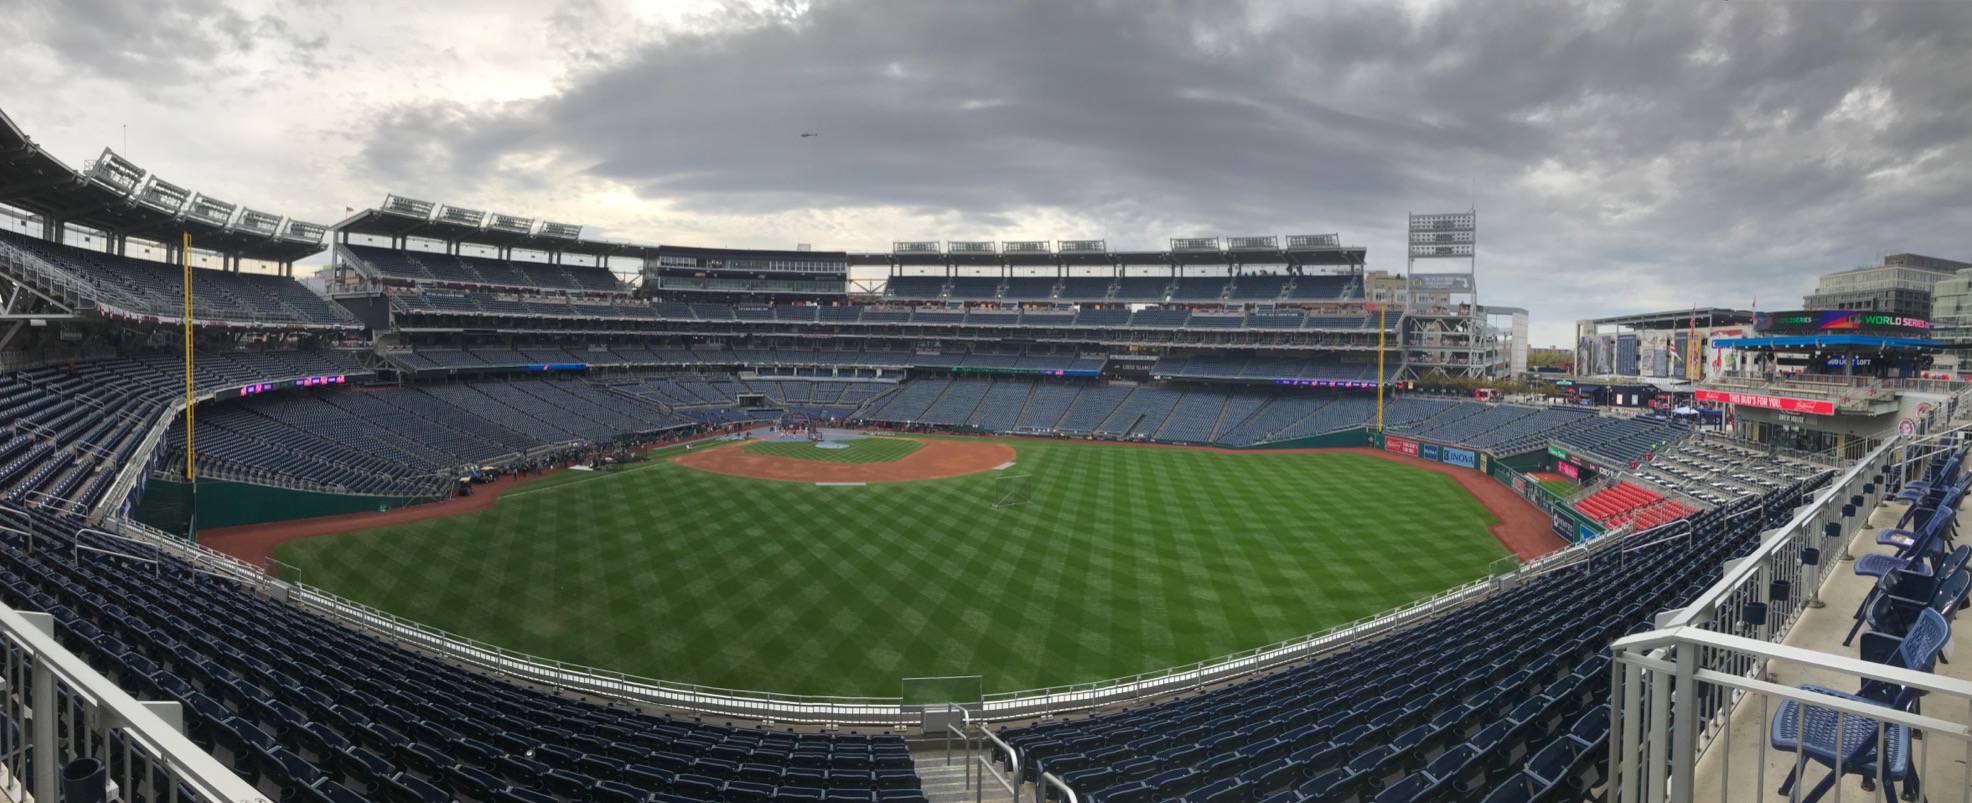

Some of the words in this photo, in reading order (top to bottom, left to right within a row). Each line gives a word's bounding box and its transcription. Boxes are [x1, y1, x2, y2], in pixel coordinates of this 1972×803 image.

[1865, 315, 1902, 326] WORLD
[1902, 317, 1925, 329] SERIES
[1857, 358, 1871, 366] LOFT
[1729, 393, 1740, 404] THIS
[1741, 394, 1757, 406] BUD'S
[1757, 396, 1767, 407] FOR
[1769, 397, 1782, 409] YOU.
[1450, 452, 1473, 464] INOVA
